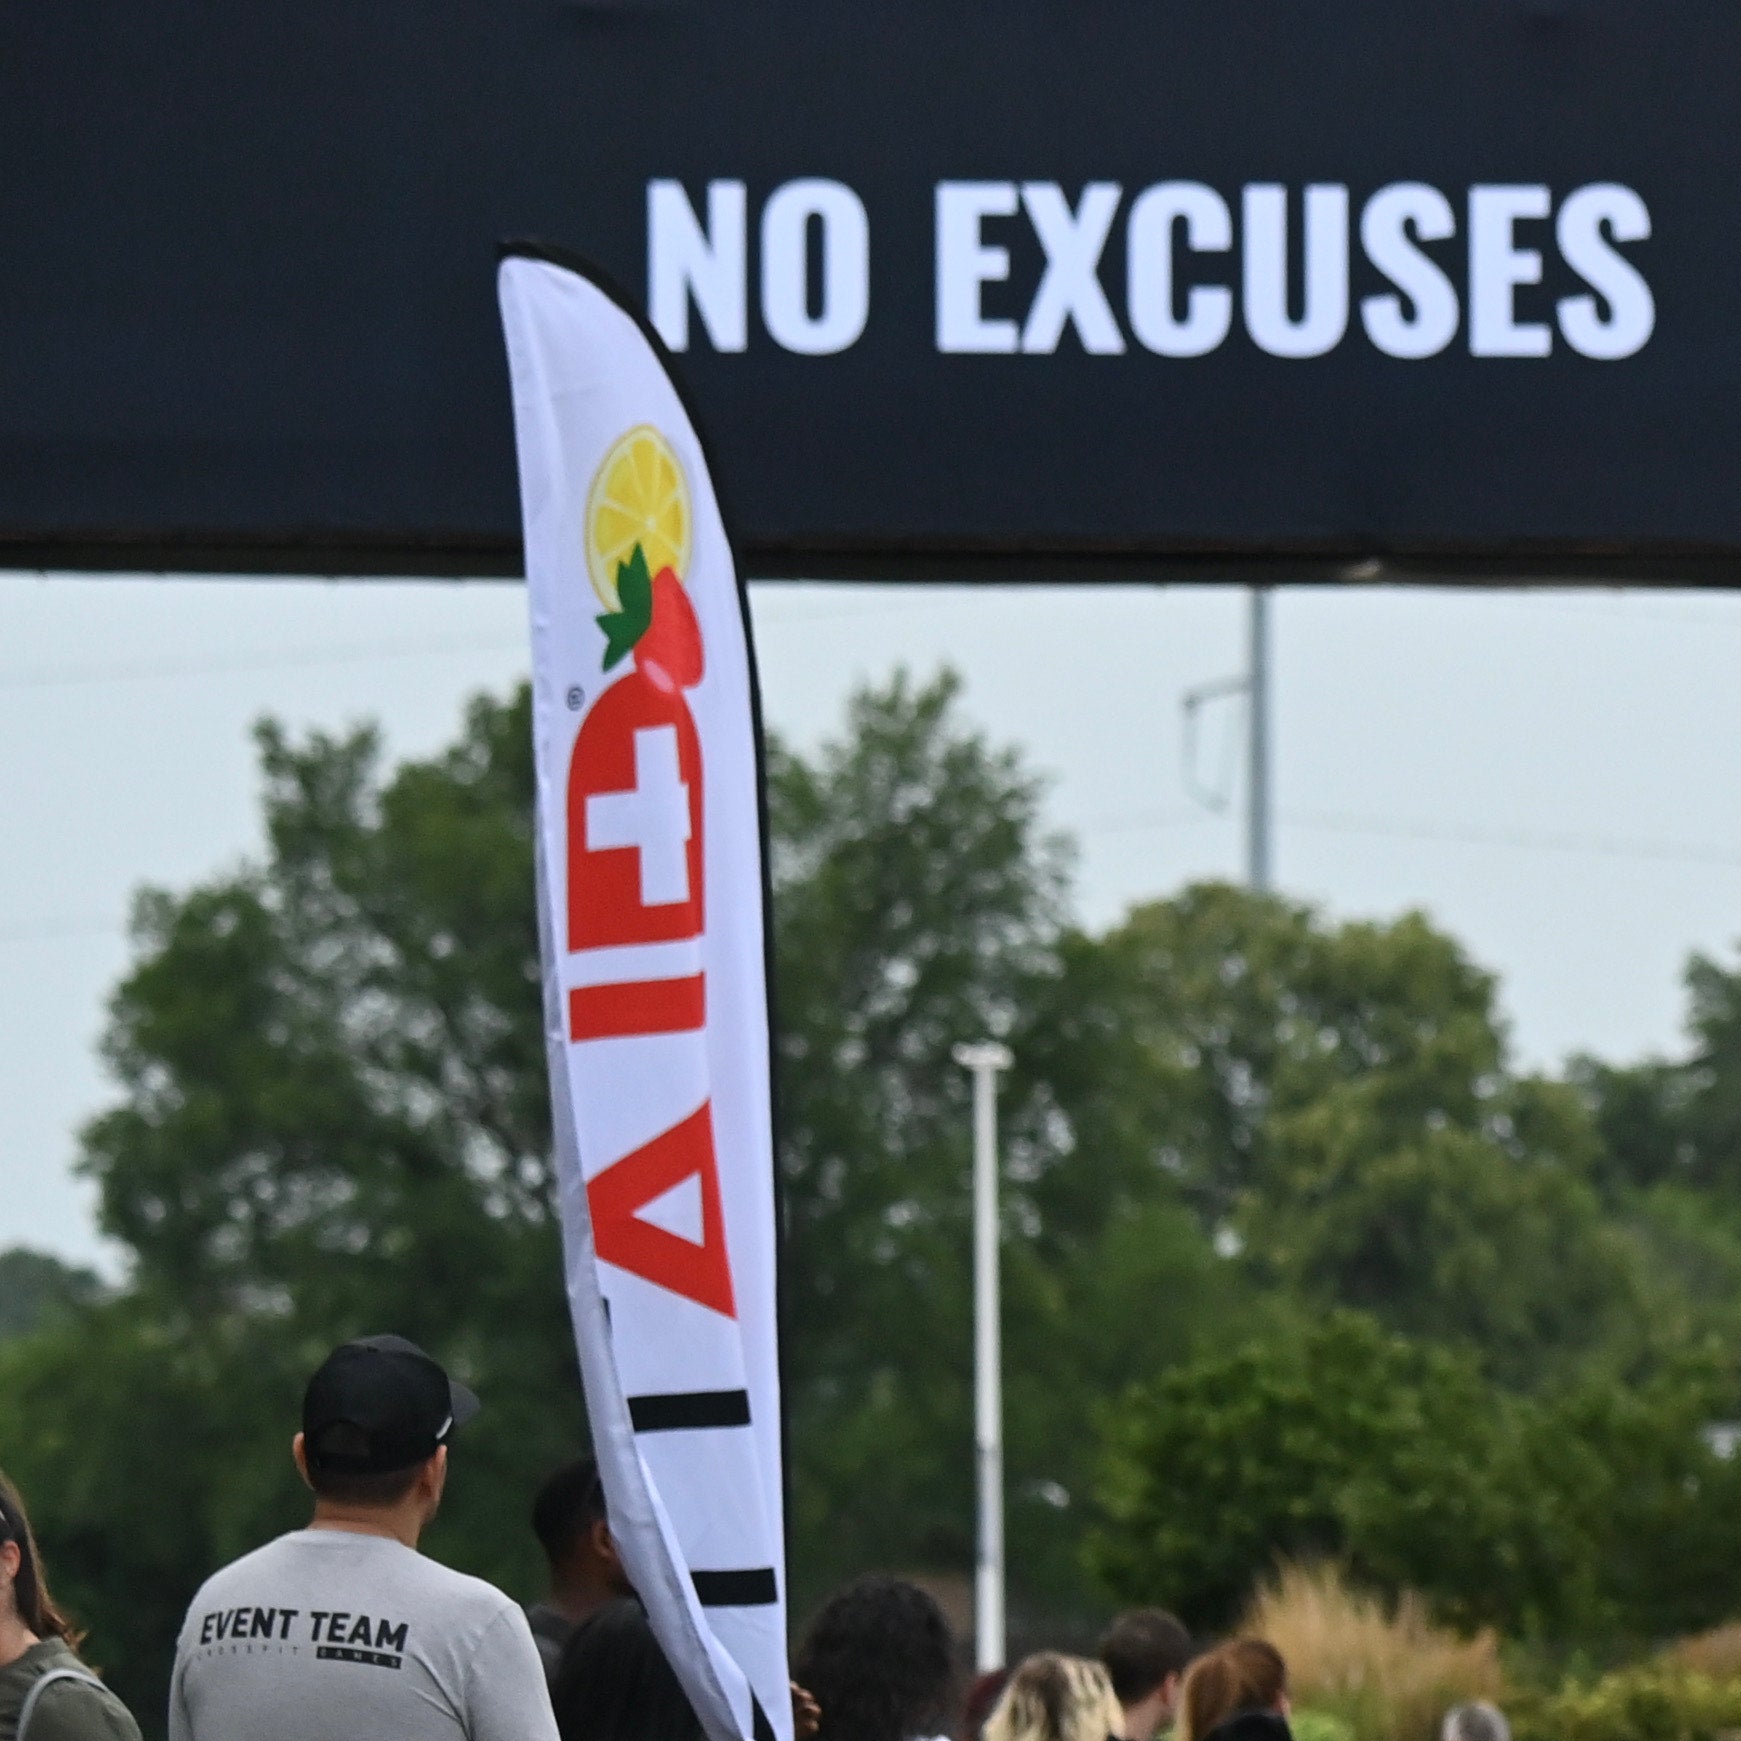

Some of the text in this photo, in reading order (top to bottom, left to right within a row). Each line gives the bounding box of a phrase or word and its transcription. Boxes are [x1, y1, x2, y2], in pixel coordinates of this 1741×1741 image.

[646, 180, 1655, 359] NO EXCUSES
[200, 1606, 409, 1653] EVENT TEAM
